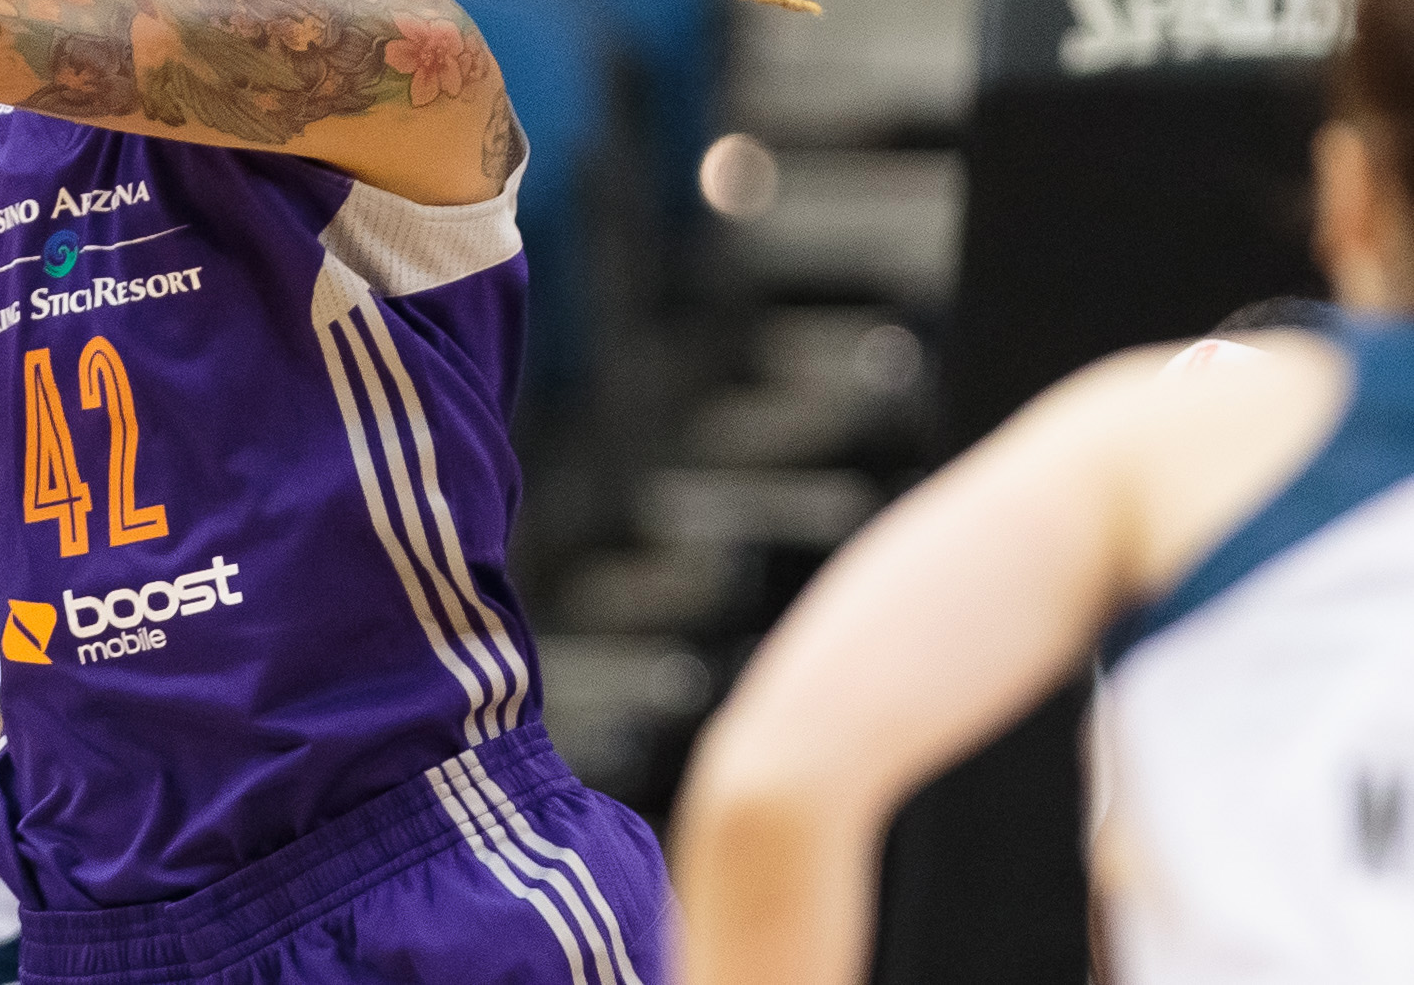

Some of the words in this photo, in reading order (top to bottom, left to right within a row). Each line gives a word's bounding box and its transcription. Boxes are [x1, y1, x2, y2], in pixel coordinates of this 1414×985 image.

[92, 266, 203, 307] RESORT
[23, 335, 169, 558] 42
[63, 556, 243, 638] boost
[77, 626, 167, 665] mobile
